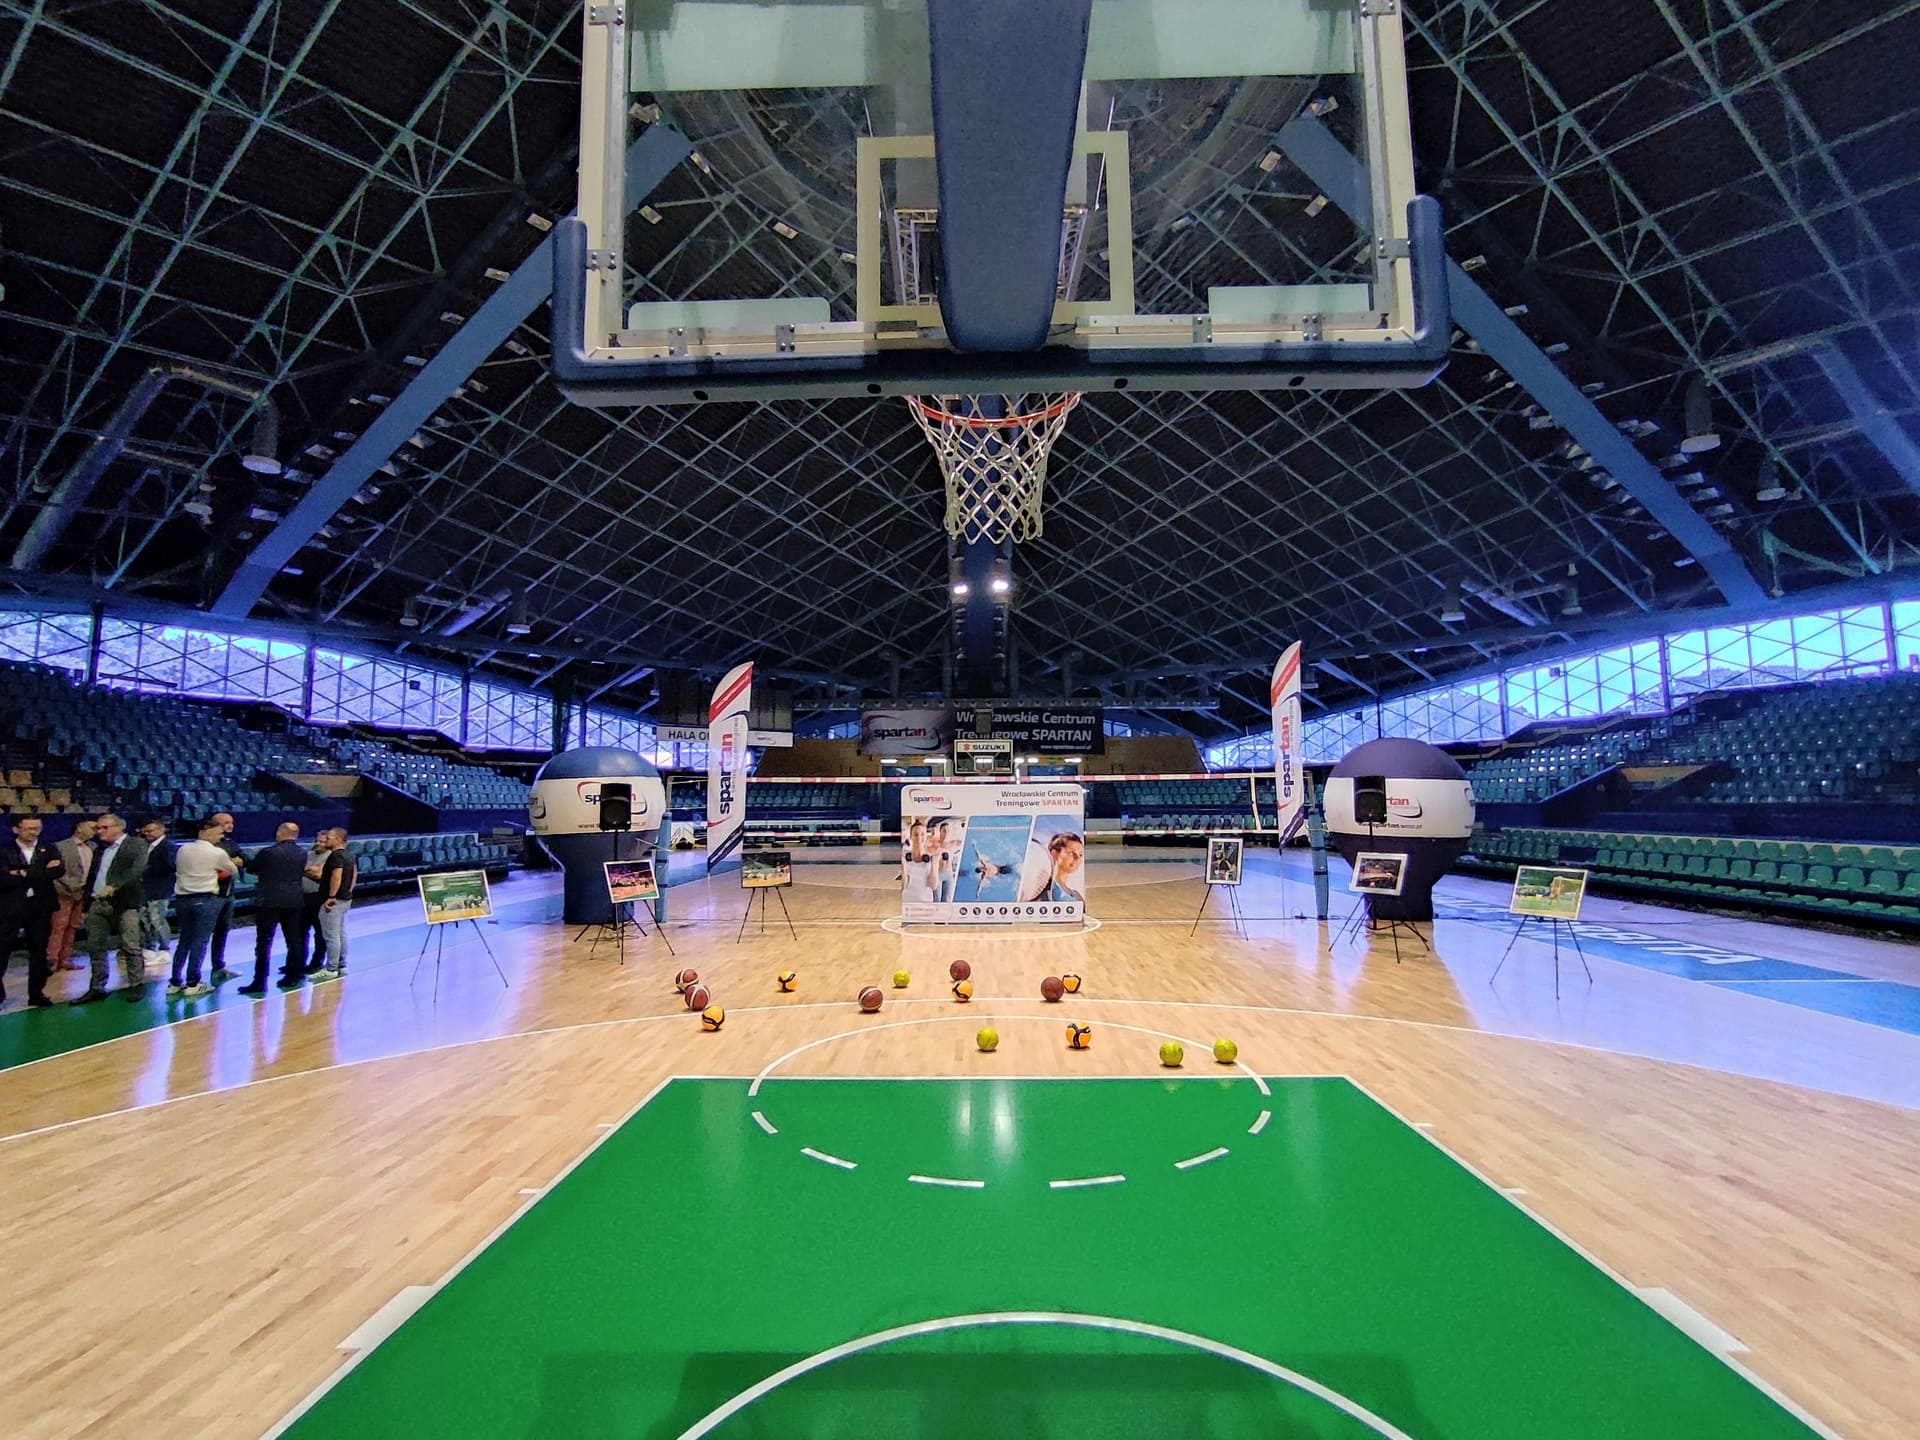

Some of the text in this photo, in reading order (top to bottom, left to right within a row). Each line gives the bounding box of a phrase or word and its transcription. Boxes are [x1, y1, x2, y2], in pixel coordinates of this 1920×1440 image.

[956, 711, 1096, 724] Wrawskie Centrum
[668, 730, 695, 740] HALA
[874, 726, 927, 740] spartan
[1032, 729, 1092, 741] SPARTAN
[1279, 716, 1294, 798] spartan
[719, 733, 734, 815] spartan
[913, 795, 944, 804] spartan
[1047, 790, 1079, 798] Centrum
[996, 799, 1079, 809] Treningowe SPARTAN
